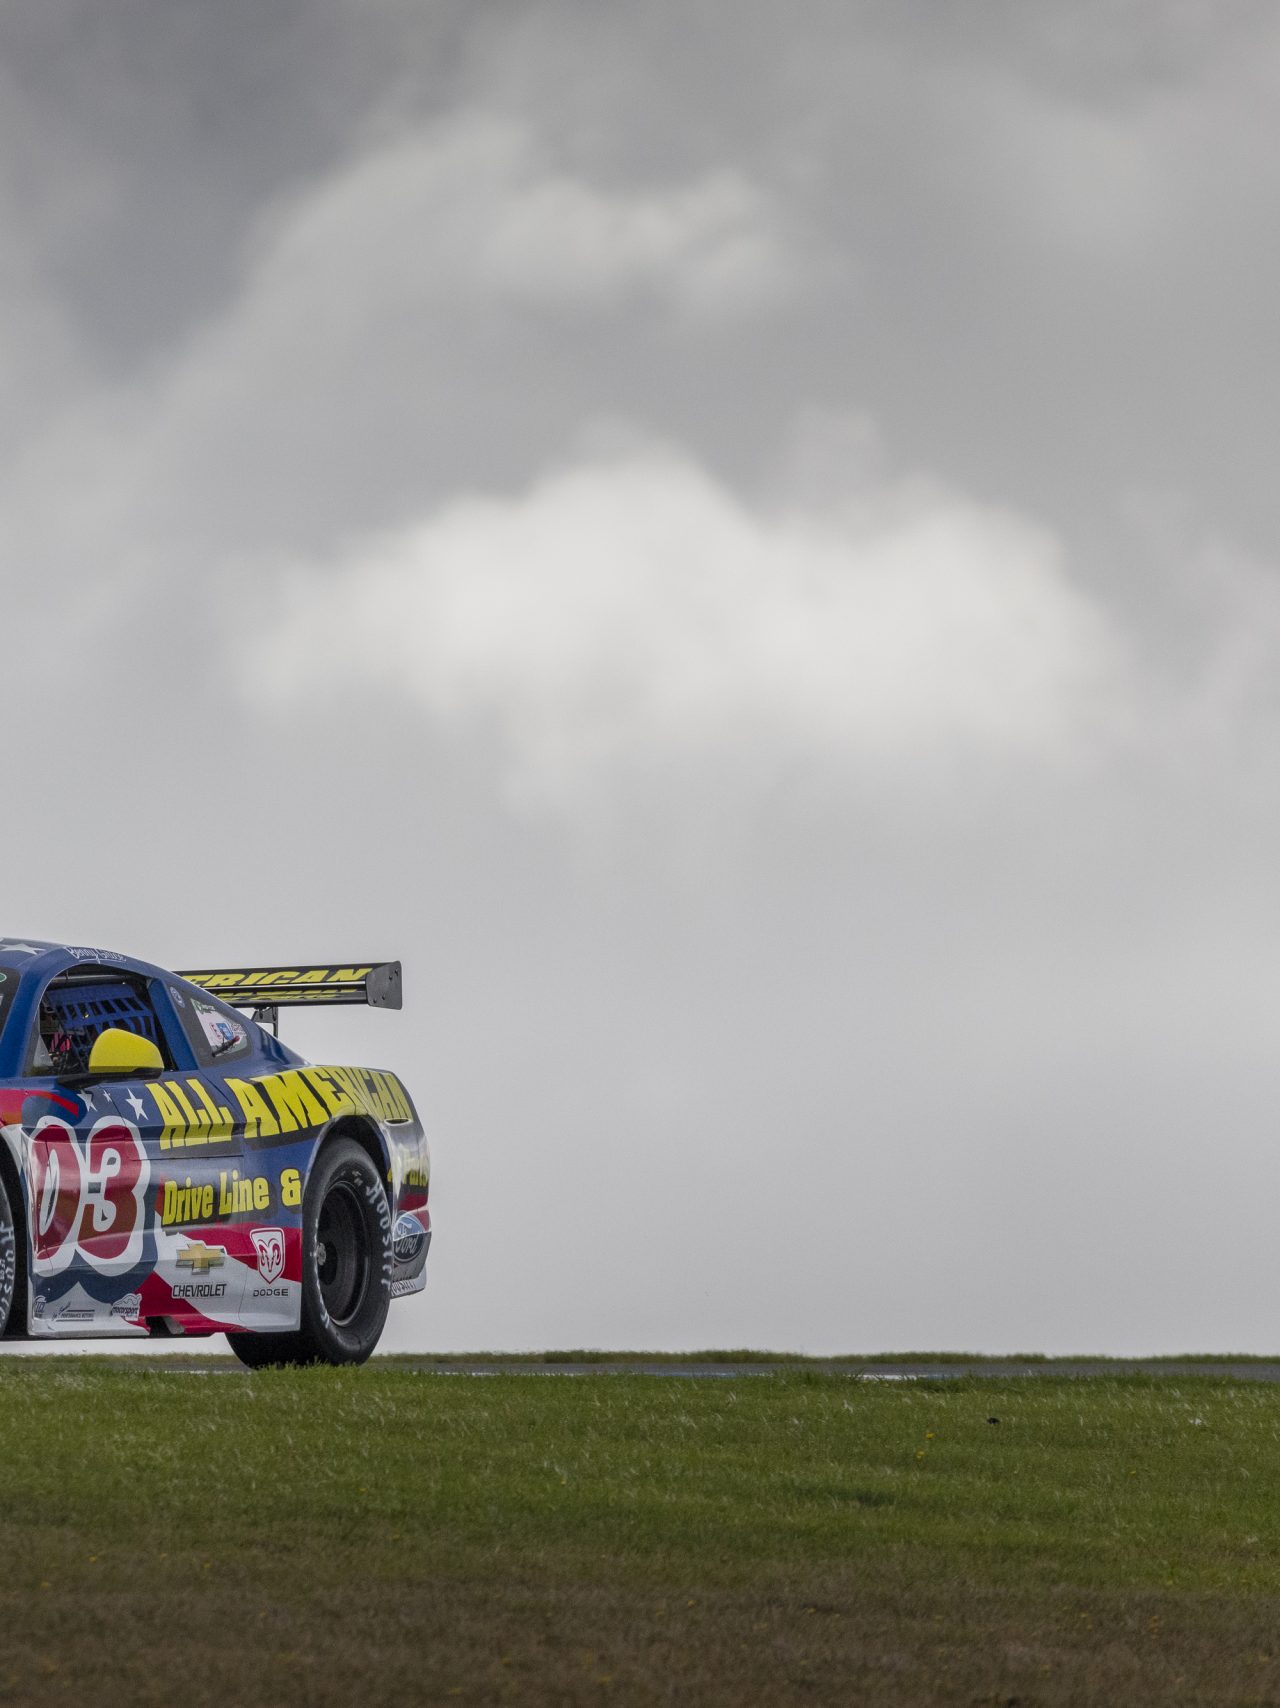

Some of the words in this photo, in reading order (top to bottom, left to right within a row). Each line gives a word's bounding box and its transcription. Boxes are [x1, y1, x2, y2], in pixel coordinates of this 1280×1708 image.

[145, 1078, 235, 1151] ALL
[224, 1066, 414, 1140] AMERICAN
[29, 1120, 147, 1270] 03
[161, 1176, 214, 1226] Drive
[219, 1169, 270, 1216] Line
[280, 1168, 301, 1207] &
[172, 1283, 227, 1298] CHEVROLET
[253, 1288, 289, 1297] DODGE
